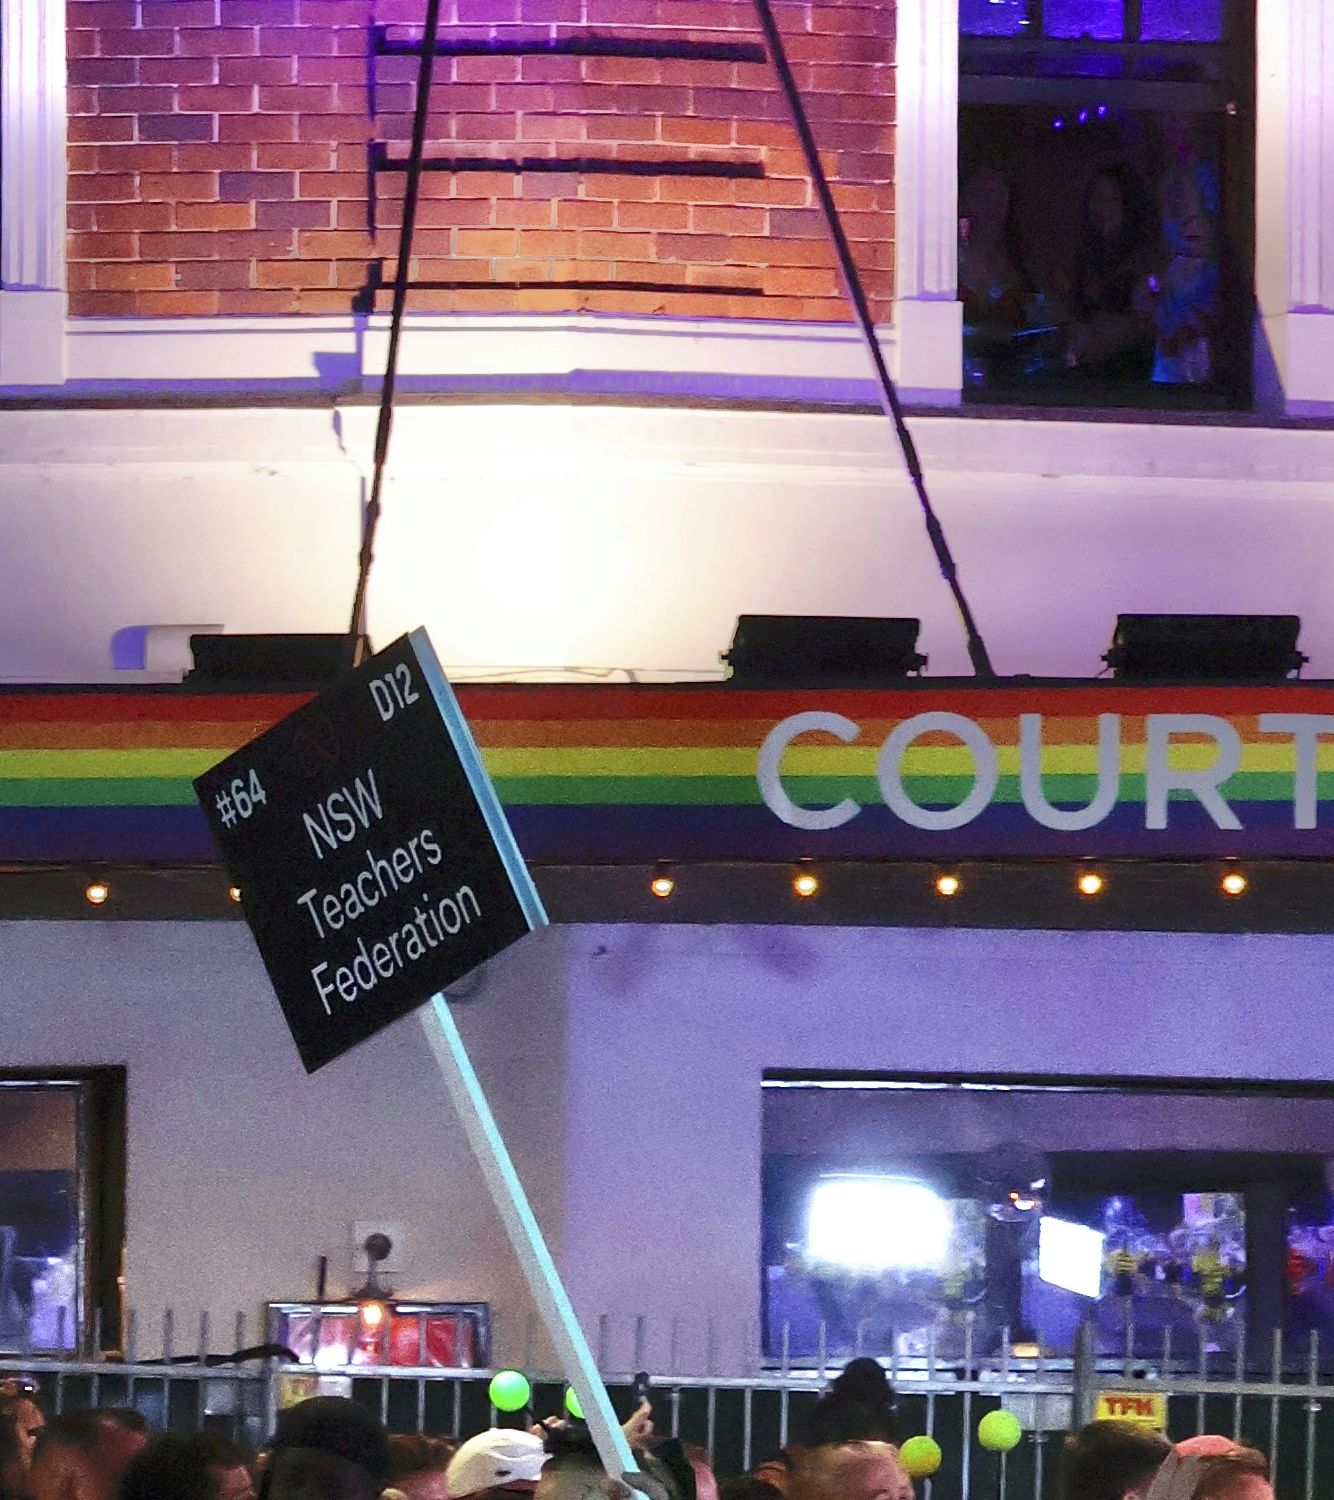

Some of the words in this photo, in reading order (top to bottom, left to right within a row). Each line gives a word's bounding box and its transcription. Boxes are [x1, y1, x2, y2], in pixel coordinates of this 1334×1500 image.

[369, 662, 421, 723] D12
[215, 768, 268, 830] #64
[302, 768, 384, 860] NSW
[297, 827, 444, 940] Teachers
[310, 883, 482, 1016] Federation
